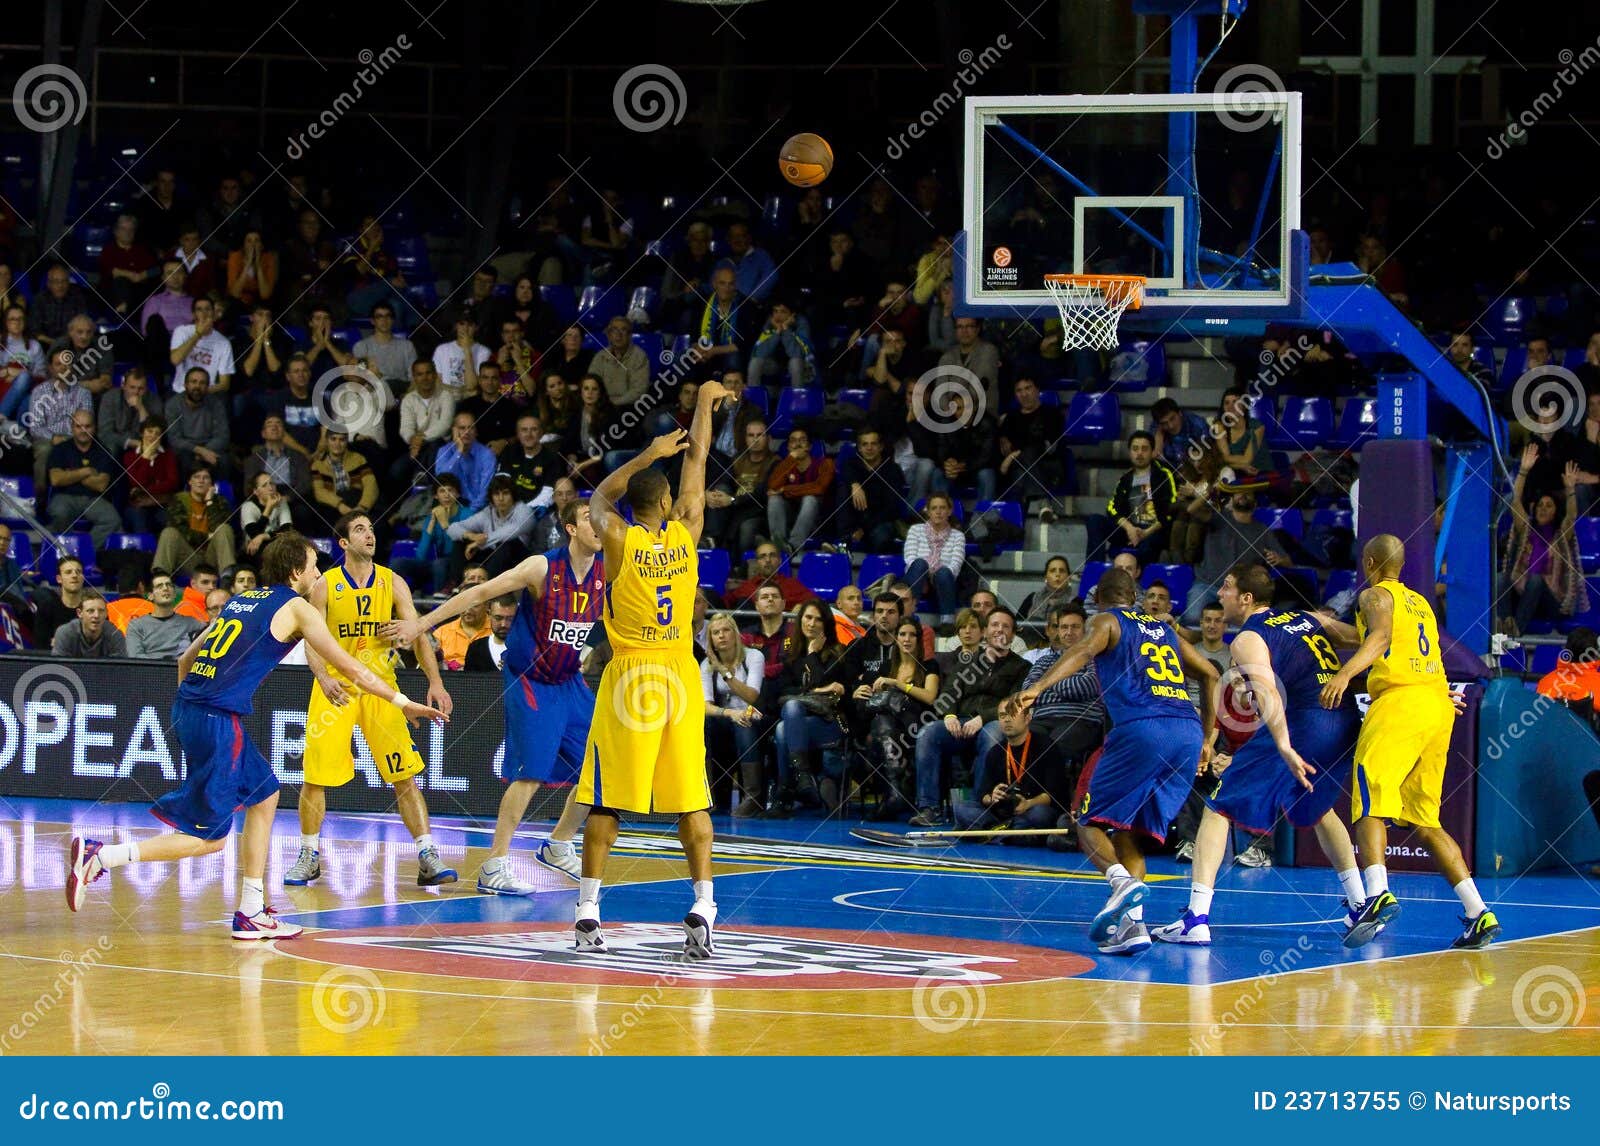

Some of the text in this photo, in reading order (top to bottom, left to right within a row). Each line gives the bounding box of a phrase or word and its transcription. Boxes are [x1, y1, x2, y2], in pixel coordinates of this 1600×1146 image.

[1394, 387, 1403, 435] MONDO
[634, 544, 689, 566] HENDRIX
[225, 600, 260, 614] Regal
[355, 594, 372, 617] 12
[573, 591, 589, 614] 17
[655, 584, 673, 626] 5
[197, 617, 243, 660] 20
[549, 619, 591, 650] Reg
[641, 625, 657, 641] TEL
[1140, 641, 1186, 685] 33
[1301, 634, 1342, 671] 13
[385, 751, 405, 775] 12
